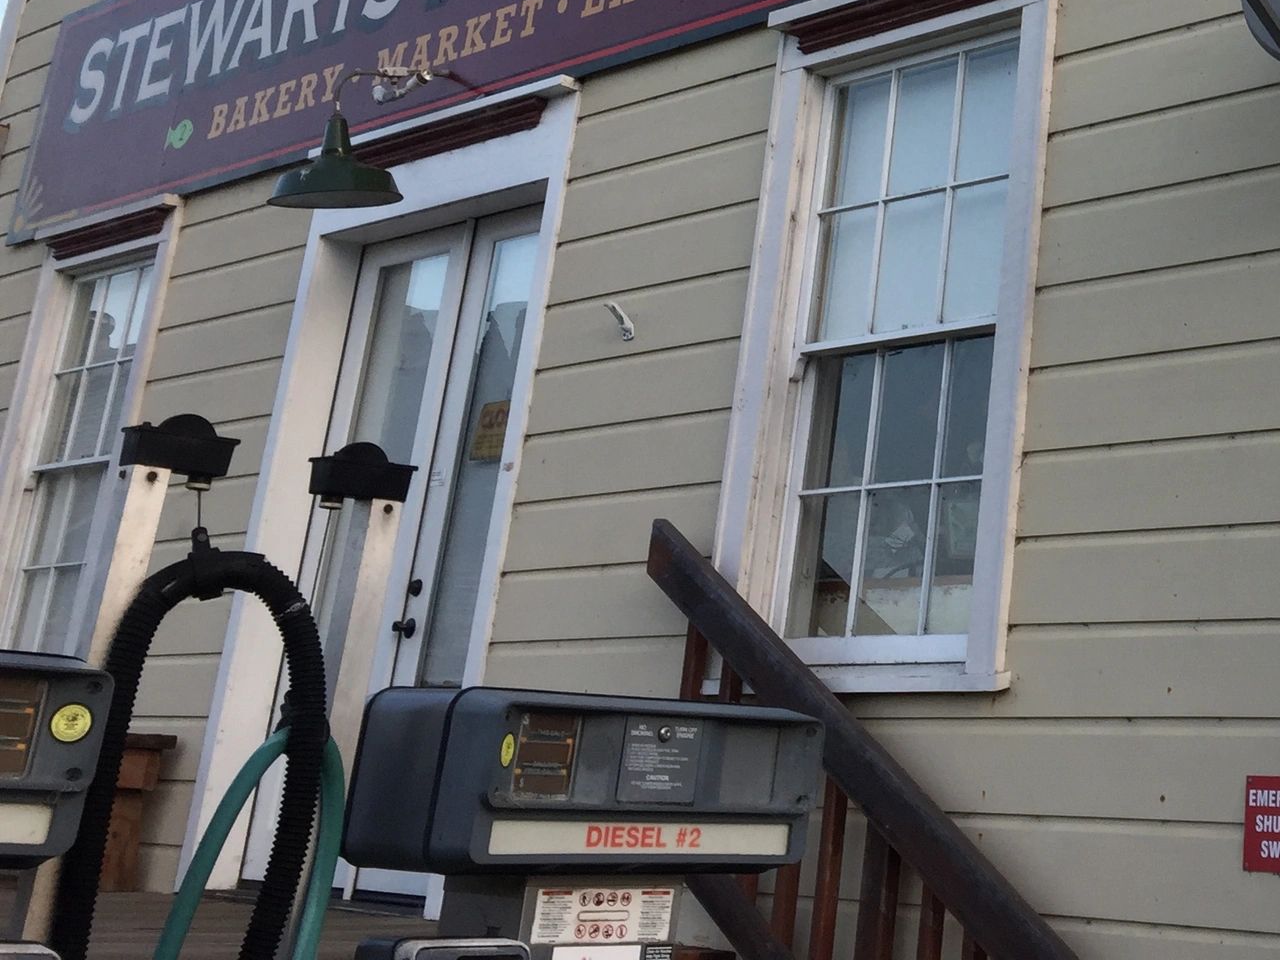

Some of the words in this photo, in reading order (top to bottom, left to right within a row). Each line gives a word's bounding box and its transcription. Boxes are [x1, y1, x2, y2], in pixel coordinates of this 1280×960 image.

[206, 62, 345, 140] BAKERY
[585, 825, 667, 848] DIESEL
[676, 827, 702, 848] #2
